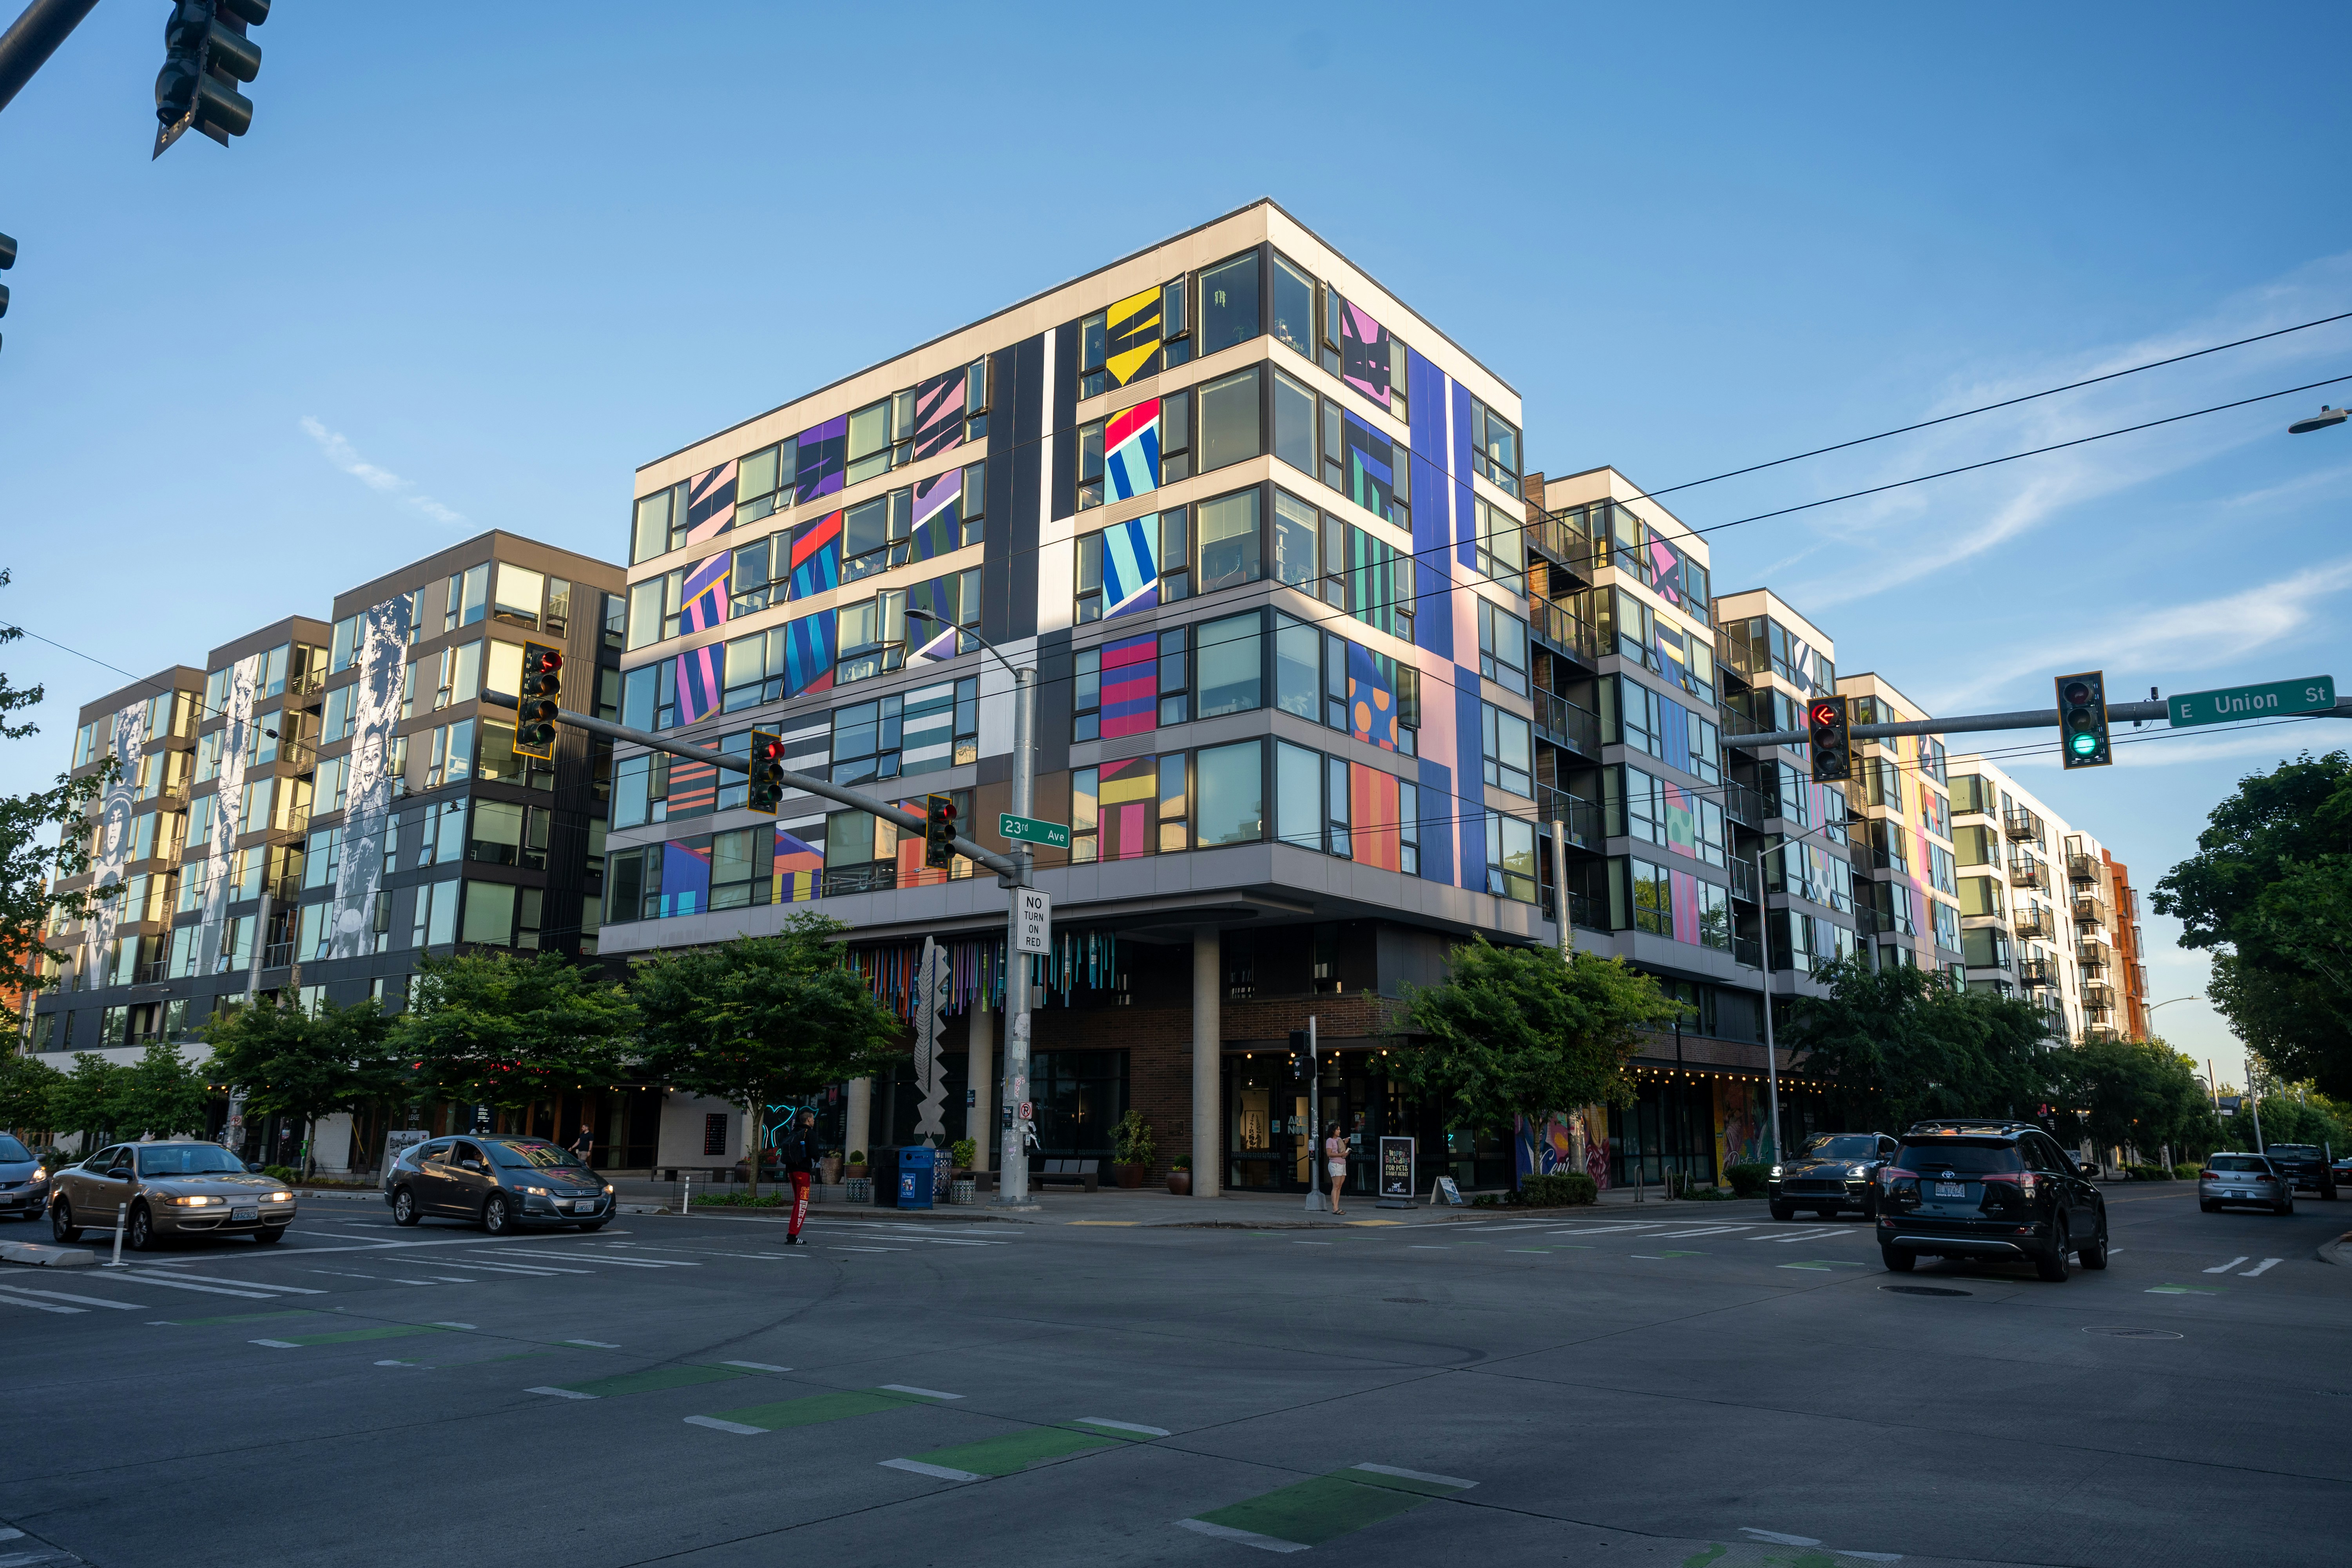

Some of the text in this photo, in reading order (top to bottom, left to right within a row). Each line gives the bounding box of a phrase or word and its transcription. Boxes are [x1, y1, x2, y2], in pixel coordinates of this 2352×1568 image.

[2180, 687, 2326, 718] E Union St
[1005, 820, 1064, 842] 23rd Ave
[1027, 896, 1042, 909] NO
[1024, 911, 1044, 922] TURN
[1029, 924, 1038, 934] ON
[1026, 937, 1041, 947] RED
[1288, 1116, 1308, 1124] ARTE
[1389, 1149, 1405, 1158] Happy
[1385, 1155, 1410, 1165] Birthdays
